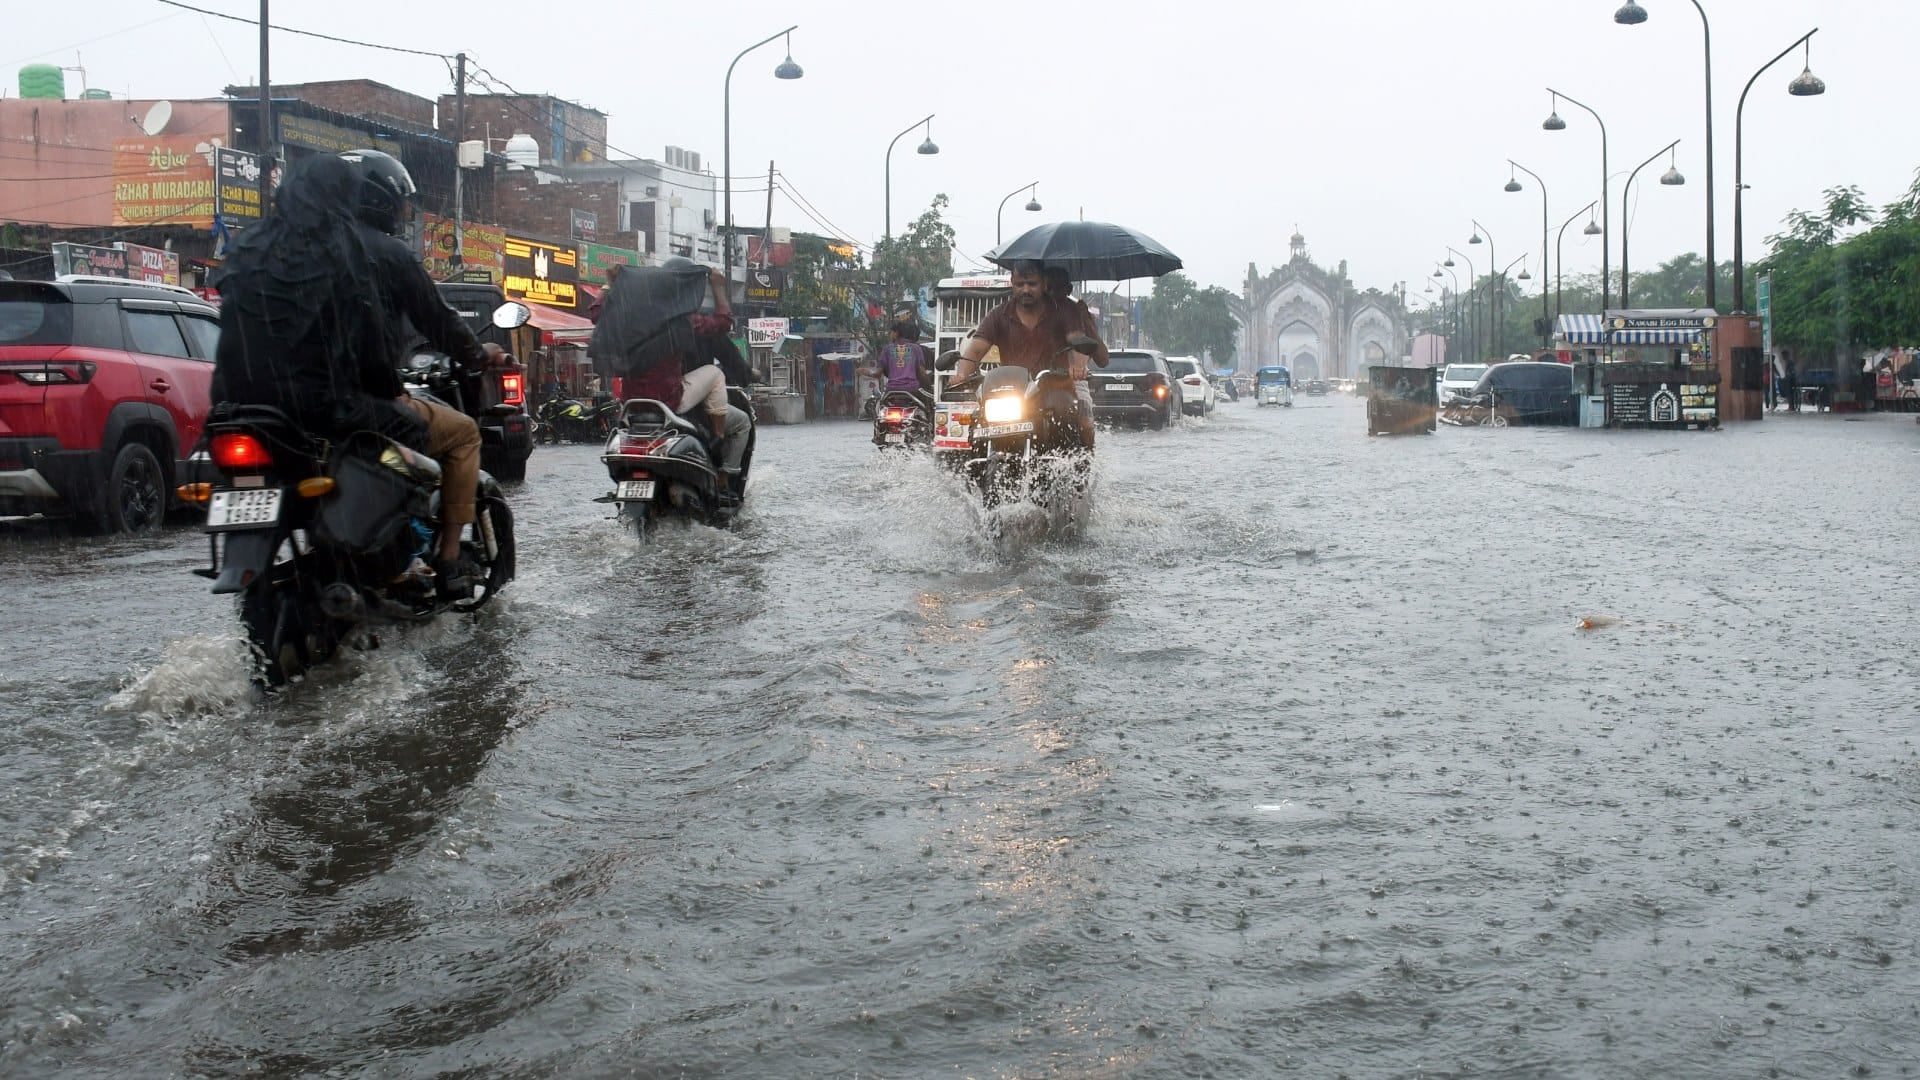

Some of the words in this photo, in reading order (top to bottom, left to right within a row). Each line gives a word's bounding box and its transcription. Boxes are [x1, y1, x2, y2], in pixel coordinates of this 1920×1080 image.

[148, 146, 191, 170] Azhar
[115, 183, 149, 201] AZHAR
[221, 184, 243, 201] AZHAR
[122, 206, 153, 218] CHICKEN
[155, 204, 183, 218] BIRYANI
[184, 203, 215, 216] CORNER
[223, 202, 244, 214] CHICKEN
[142, 250, 163, 271] PIZZA
[550, 282, 574, 297] CORNER
[765, 289, 780, 297] CAFE
[1628, 319, 1658, 327] NAWABI
[1660, 319, 1678, 327] EGG
[1679, 319, 1700, 327] ROLL
